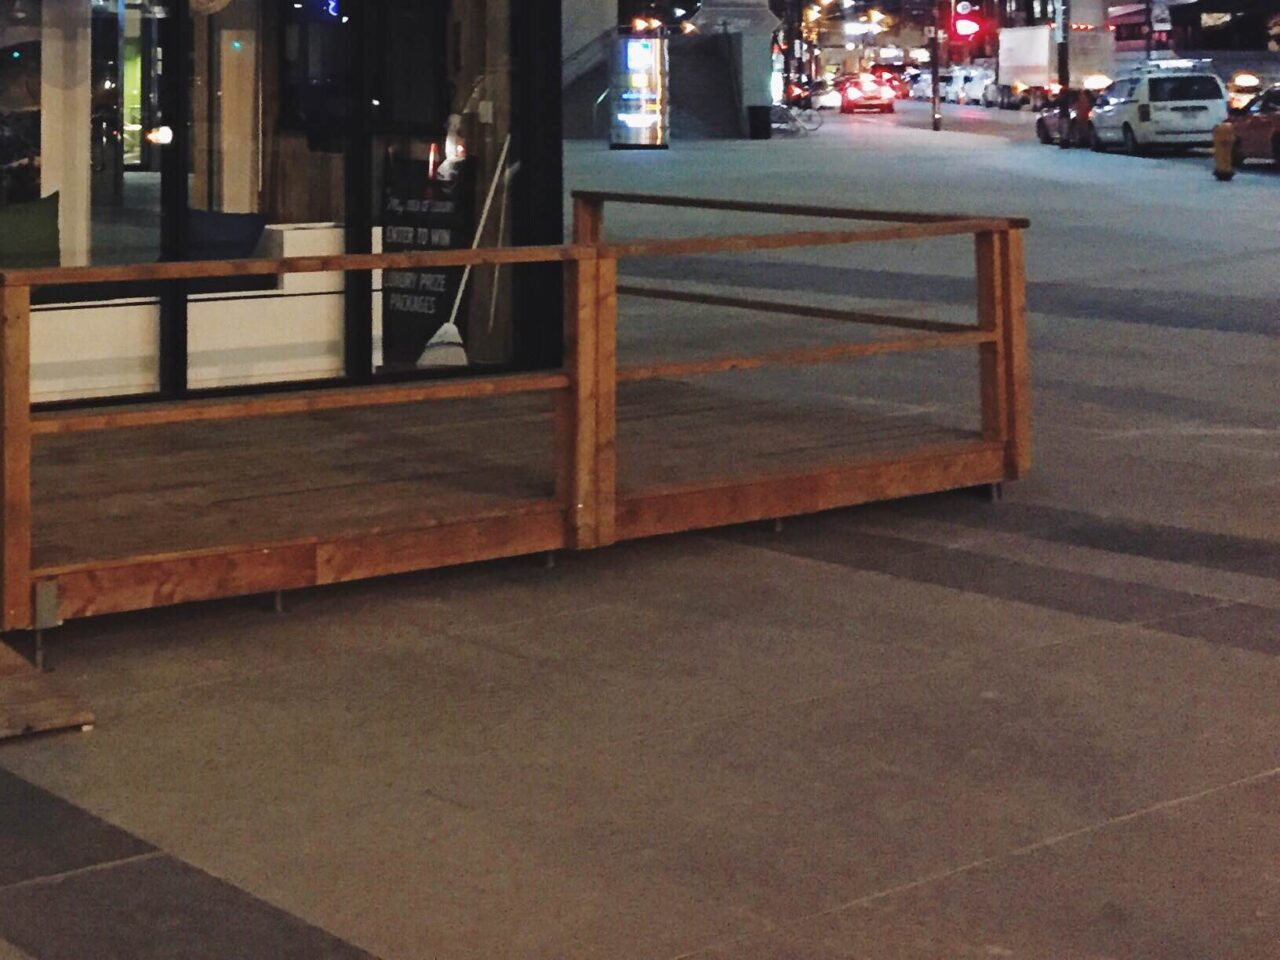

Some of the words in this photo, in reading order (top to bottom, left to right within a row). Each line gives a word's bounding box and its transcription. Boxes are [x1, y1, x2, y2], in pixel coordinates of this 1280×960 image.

[386, 226, 415, 244] ENTER
[417, 227, 429, 245] TO
[431, 228, 452, 247] WIN
